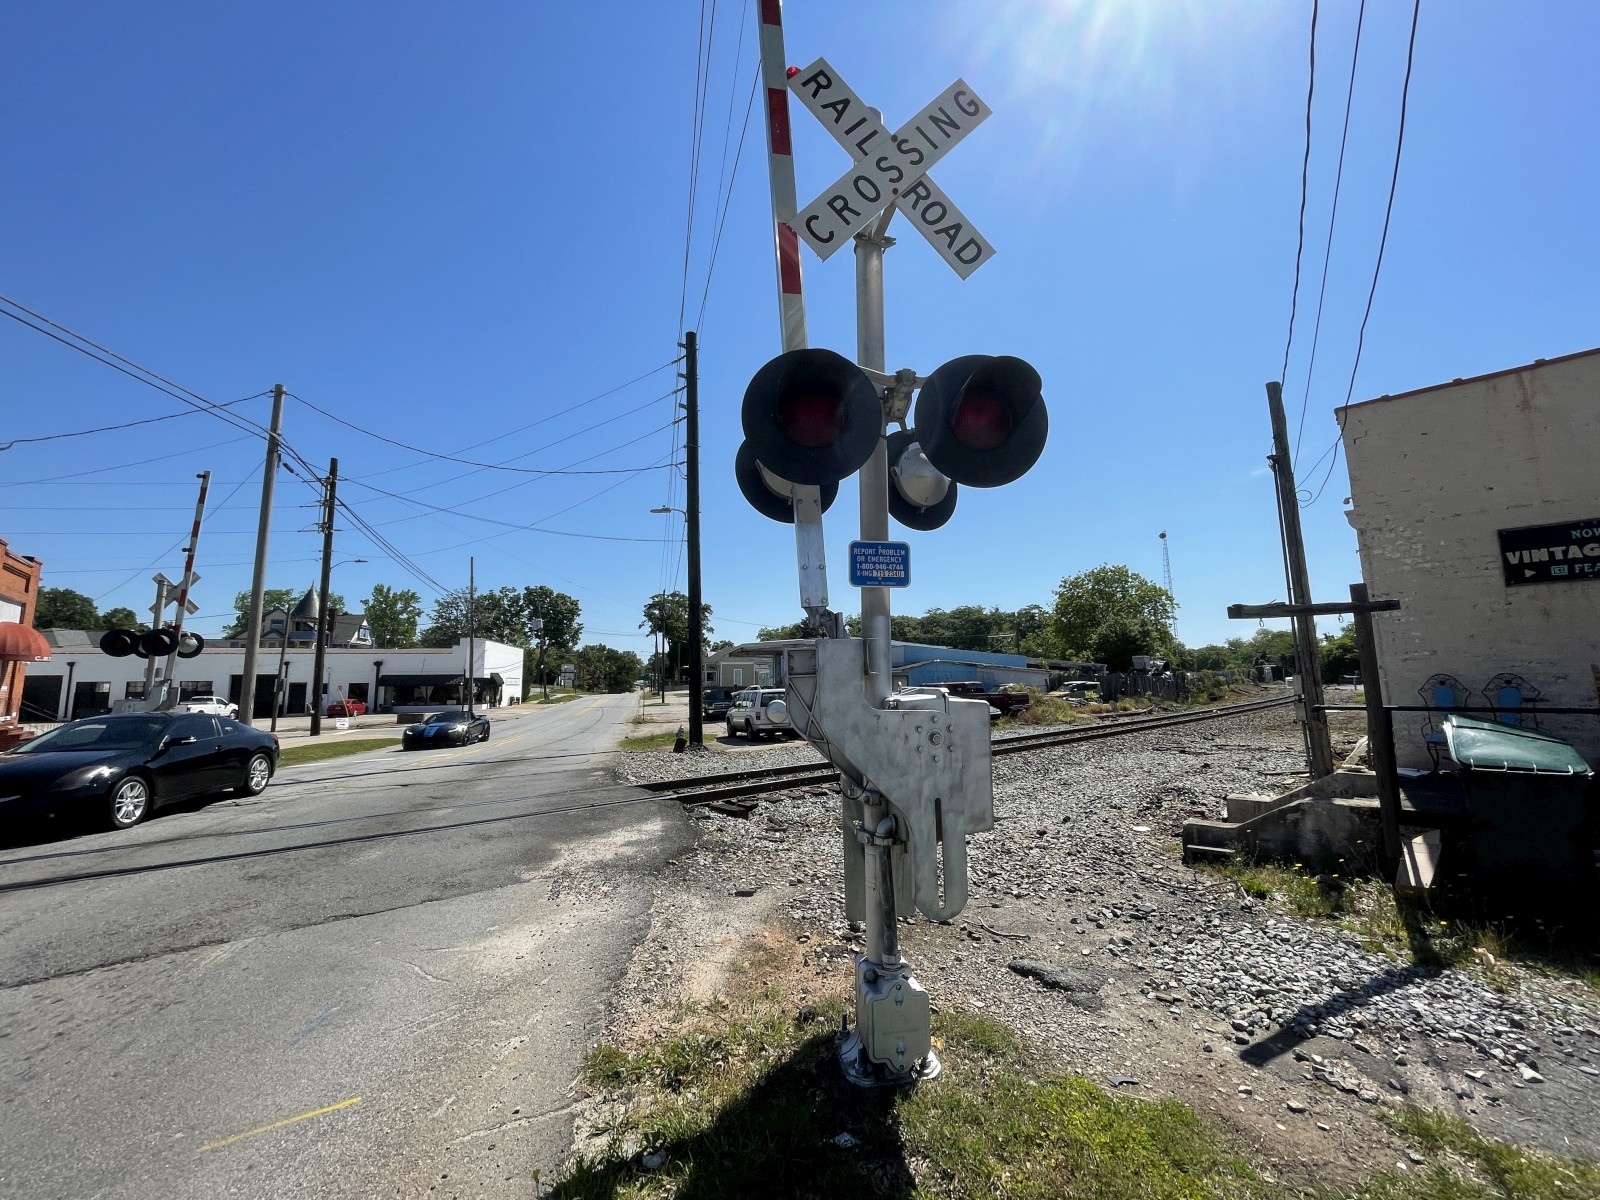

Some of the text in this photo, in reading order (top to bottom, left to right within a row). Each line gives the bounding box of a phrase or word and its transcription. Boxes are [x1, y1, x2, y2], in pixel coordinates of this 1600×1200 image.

[801, 69, 879, 157] RAIL
[805, 90, 980, 244] CROSSING
[901, 180, 983, 265] ROAD
[853, 547, 906, 556] REPORT PROBLEM
[867, 555, 903, 563] EMERGENCY
[1505, 543, 1600, 565] VINTAG
[856, 563, 904, 571] 1-800-946-4744
